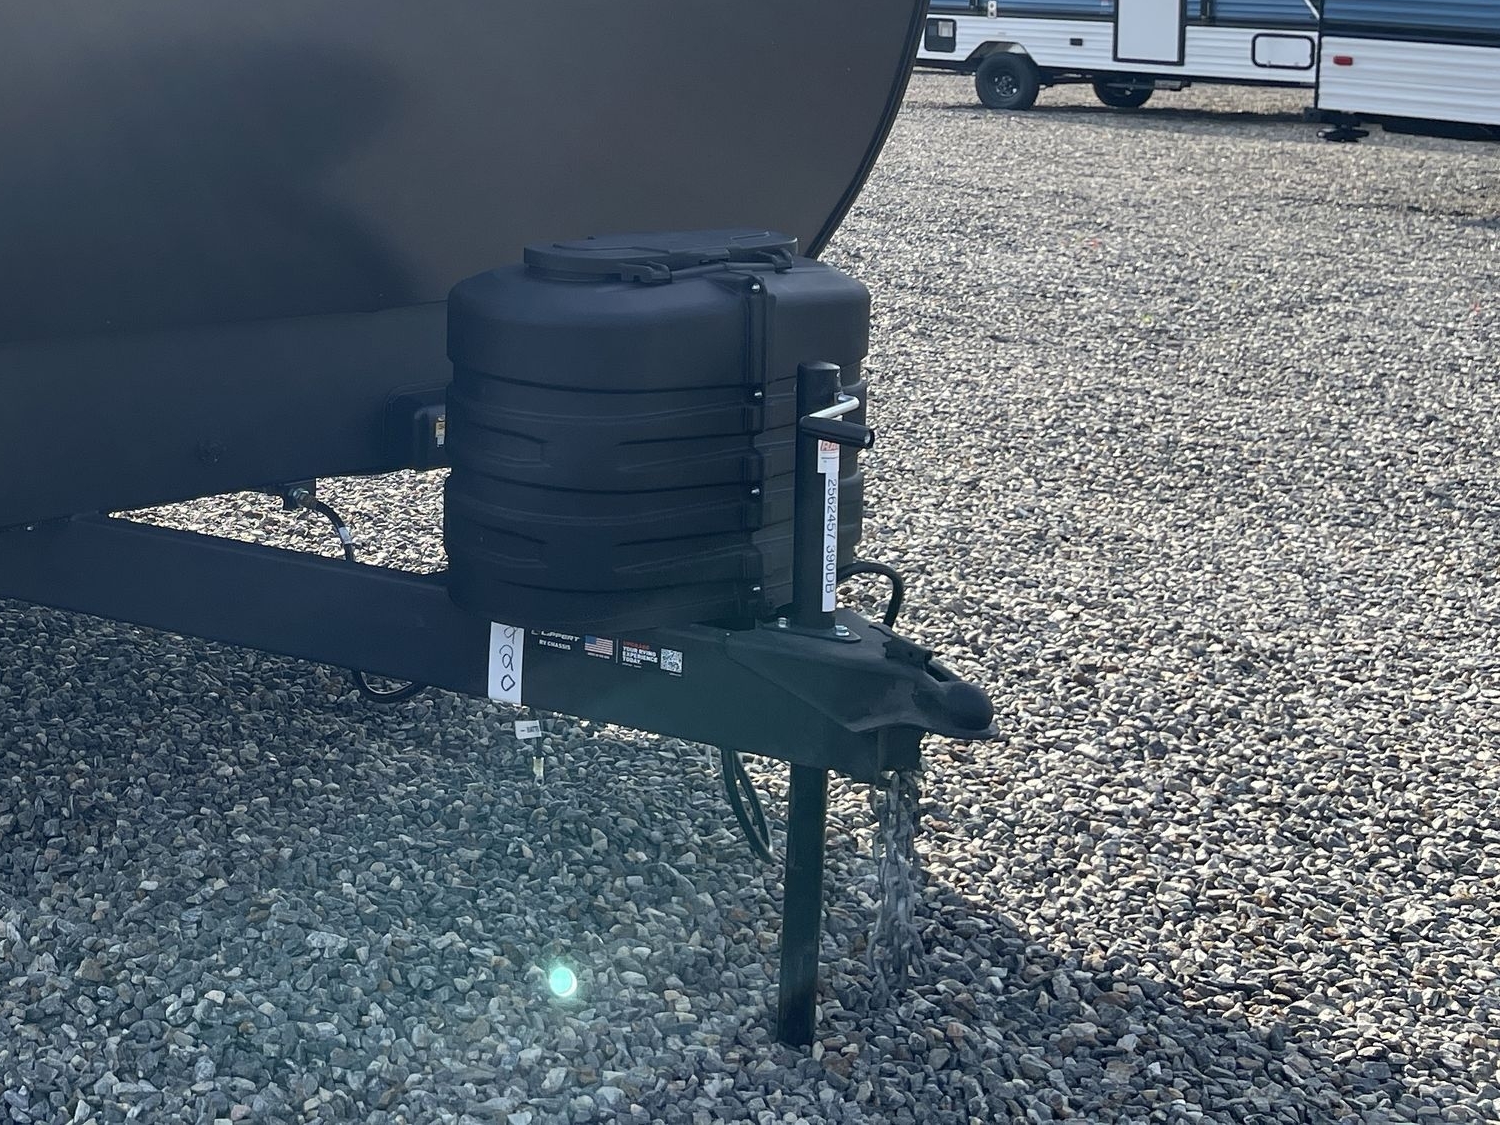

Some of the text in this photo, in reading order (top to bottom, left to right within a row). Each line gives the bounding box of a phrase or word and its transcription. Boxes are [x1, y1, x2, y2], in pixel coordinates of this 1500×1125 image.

[824, 479, 838, 594] 2562457 390DB
[547, 641, 571, 651] CHASSIS
[623, 645, 638, 653] YOUR
[622, 651, 658, 663] EXPERIENCE
